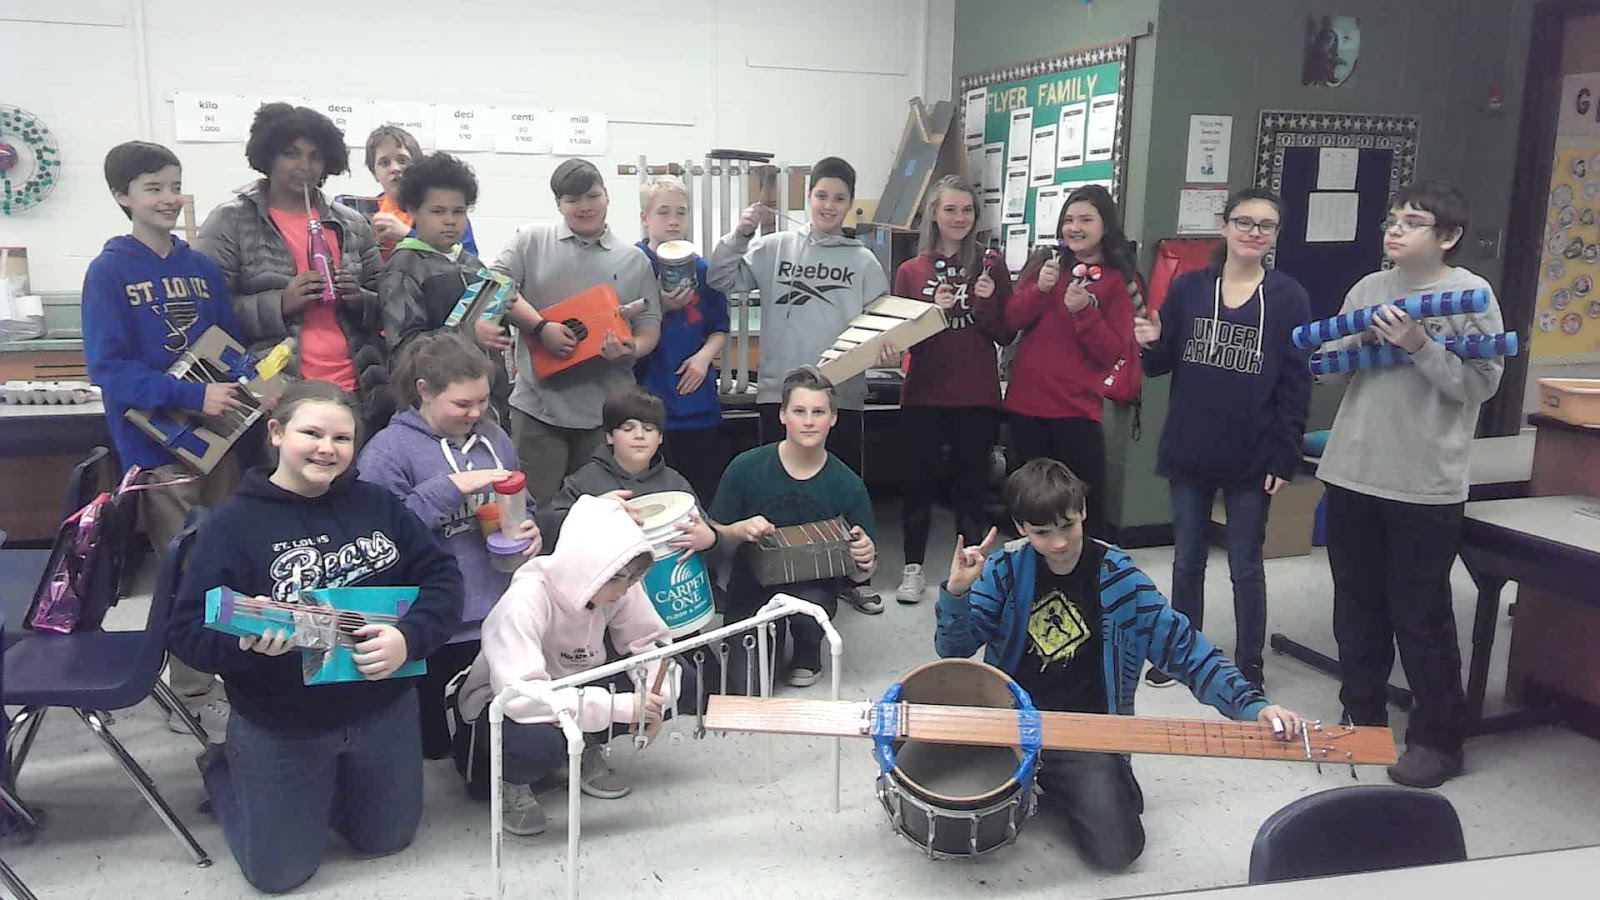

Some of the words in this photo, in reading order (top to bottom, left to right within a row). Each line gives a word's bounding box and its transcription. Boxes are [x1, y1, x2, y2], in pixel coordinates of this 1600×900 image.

[199, 100, 218, 109] kilo
[986, 86, 1027, 114] FLYER
[1038, 73, 1098, 107] FAMILY
[328, 104, 352, 113] deca
[454, 110, 474, 119] deci
[511, 113, 534, 121] centi
[570, 115, 589, 124] milli
[778, 261, 855, 286] Reebok
[1193, 317, 1260, 351] UNDER
[1182, 339, 1265, 374] ARMOUR
[655, 571, 706, 603] CARPET
[671, 589, 702, 611] ONE
